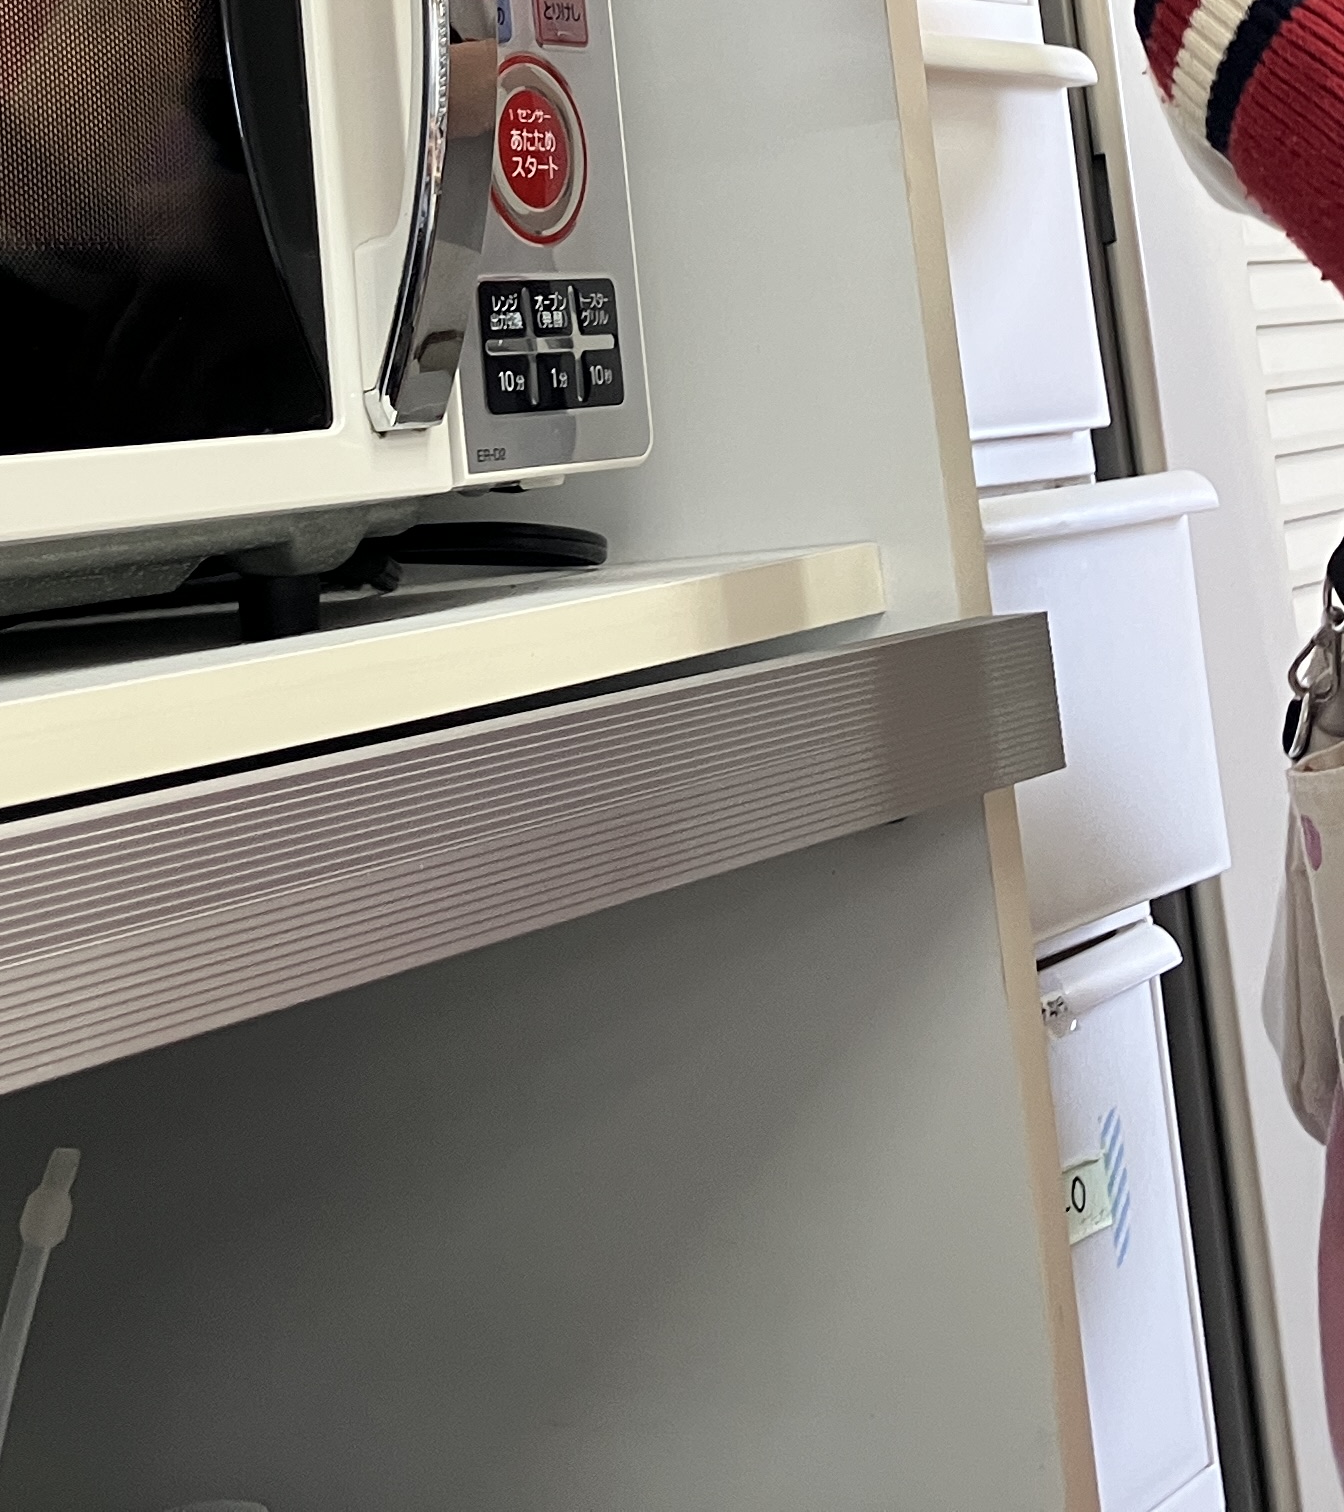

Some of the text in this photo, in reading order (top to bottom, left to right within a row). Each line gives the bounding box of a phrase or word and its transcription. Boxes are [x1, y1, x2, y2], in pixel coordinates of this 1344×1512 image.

[543, 1, 581, 22] とりけし
[517, 108, 552, 123] センサー
[510, 128, 557, 152] あたため
[512, 155, 559, 180] スタート
[491, 293, 518, 312] レンジ
[534, 291, 567, 311] オーブン
[579, 292, 609, 309] トースター
[581, 308, 609, 327] グリル
